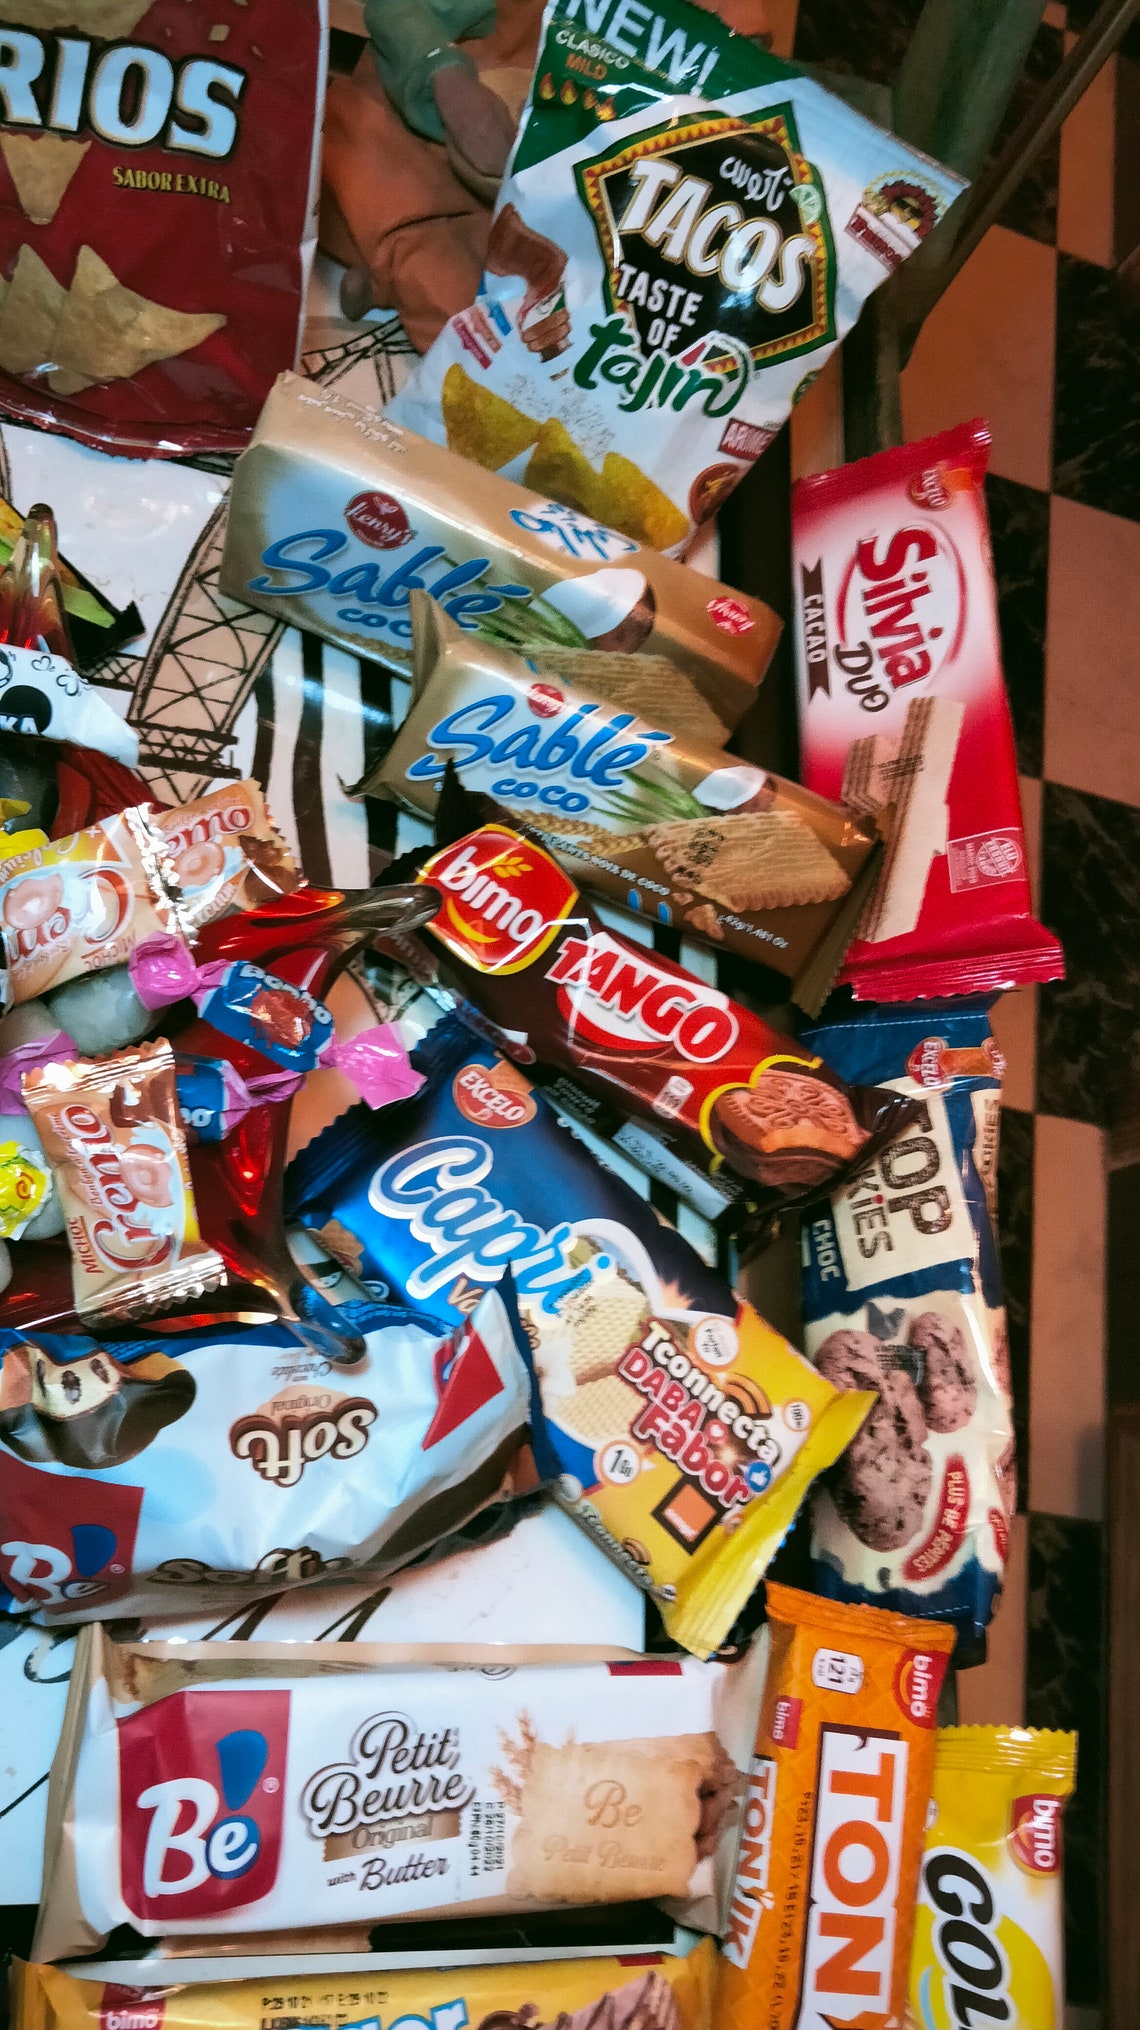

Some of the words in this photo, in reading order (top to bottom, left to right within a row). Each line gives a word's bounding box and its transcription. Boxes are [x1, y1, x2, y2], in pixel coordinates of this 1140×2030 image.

[565, 53, 608, 81] MILD
[112, 167, 173, 192] SABOR
[176, 174, 231, 204] EXTRA
[617, 159, 815, 314] TACOS
[618, 263, 703, 326] TASTE
[647, 318, 683, 352] OF
[247, 527, 534, 632] Sablé
[856, 525, 943, 691] Silvia
[337, 607, 413, 638] coc
[802, 593, 826, 663] CACAO
[407, 695, 673, 790] Sablé
[492, 776, 591, 813] coco
[440, 846, 543, 944] bimo
[636, 876, 670, 897] COCO
[545, 933, 739, 1063] TANGO
[459, 1071, 526, 1122] EXCELO
[68, 1215, 104, 1274] MICHOC
[369, 1135, 616, 1316] Capri
[811, 1219, 840, 1282] CHOC
[271, 1392, 332, 1416] Original
[618, 1346, 706, 1431] DABA
[236, 1407, 376, 1487] Soft
[632, 1404, 752, 1508] Fabor
[946, 1469, 968, 1504] PLUS
[1, 1540, 108, 1602] Be
[827, 1654, 847, 1685] 121
[909, 1654, 935, 1718] bimo
[359, 1717, 459, 1780] Petit
[311, 1767, 473, 1831] Beurre
[584, 1779, 644, 1829] Be
[137, 1777, 260, 1898] Be
[352, 1817, 433, 1850] Original
[326, 1870, 357, 1888] with
[358, 1851, 450, 1892] Butter
[925, 1854, 1009, 2030] GOL
[105, 2008, 158, 2030] bimo
